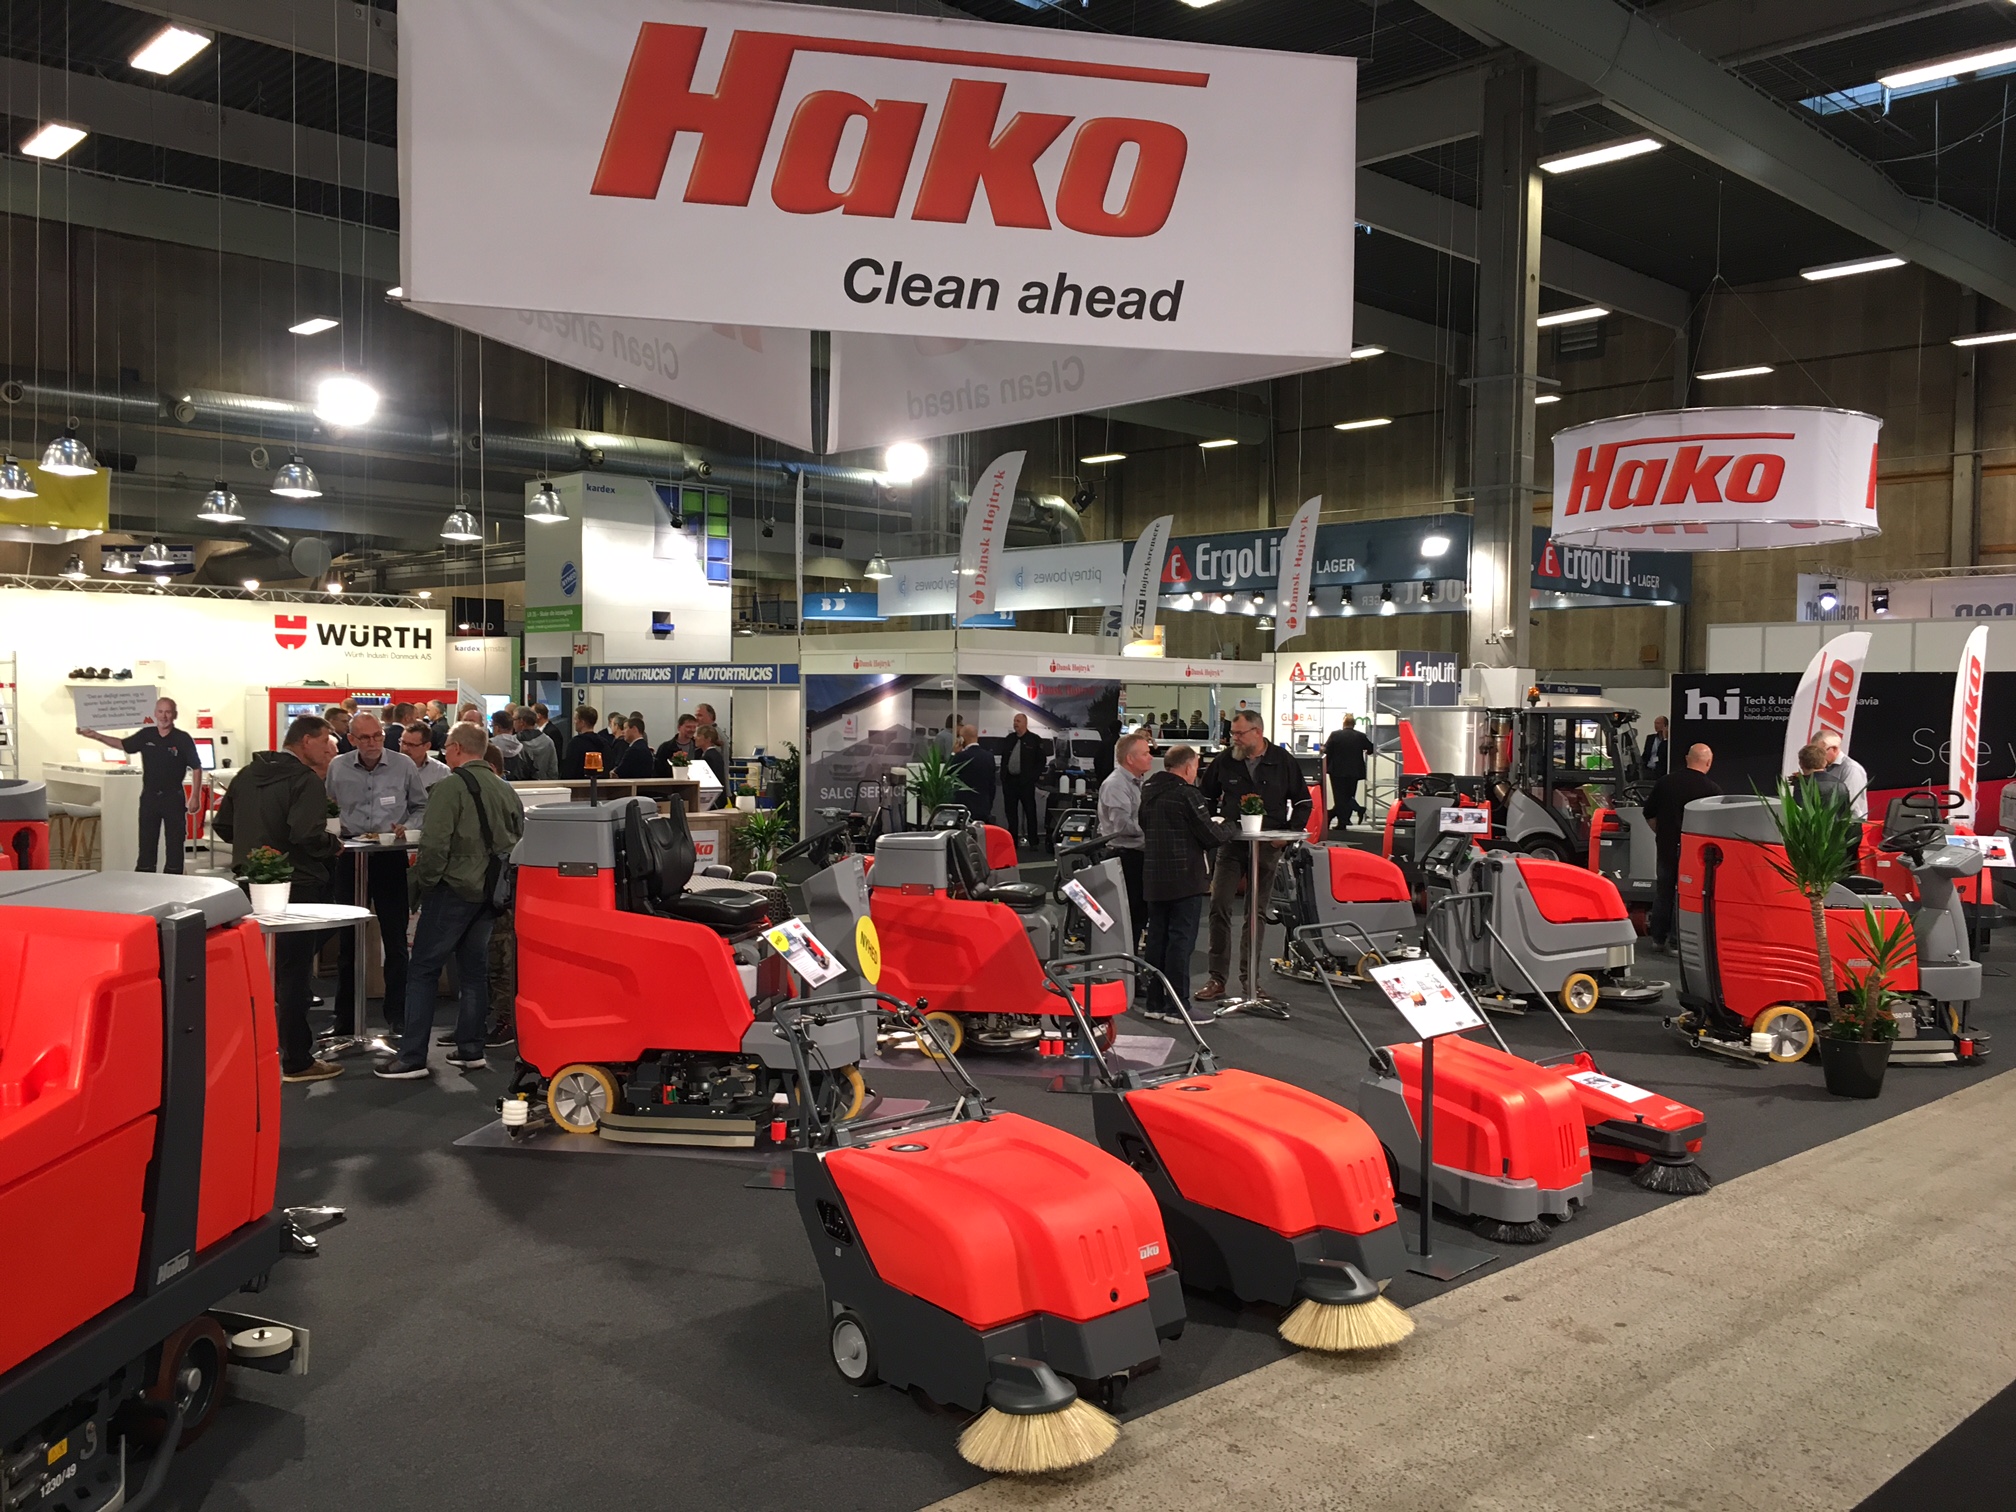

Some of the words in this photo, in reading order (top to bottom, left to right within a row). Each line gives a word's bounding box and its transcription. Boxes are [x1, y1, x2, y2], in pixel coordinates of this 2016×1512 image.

[590, 21, 1210, 238] Hako
[843, 257, 999, 312] Clean
[1018, 274, 1185, 323] ahead
[1565, 432, 1795, 516] Hako
[586, 483, 616, 494] kardex
[974, 537, 991, 587] Dansk
[1315, 558, 1356, 574] LAGER
[1289, 573, 1301, 613] Dansk
[1637, 574, 1660, 588] LAGER
[316, 622, 433, 650] WÜRTH
[344, 651, 365, 660] Würth
[366, 651, 389, 660] Industri
[391, 652, 419, 661] Danmark
[593, 668, 604, 681] AF
[607, 667, 672, 681] MOTORTRUCKS
[682, 667, 695, 681] AF
[698, 667, 773, 681] MOTORTRUCKS
[1309, 661, 1370, 685] ErgoLift
[1415, 661, 1456, 687] ErgoLift
[1744, 696, 1766, 705] Tech
[1768, 696, 1776, 705] &
[1744, 706, 1760, 714] Expo
[1959, 648, 1983, 801] Hako
[860, 930, 878, 965] NYHED
[40, 1463, 77, 1498] 1230/49
